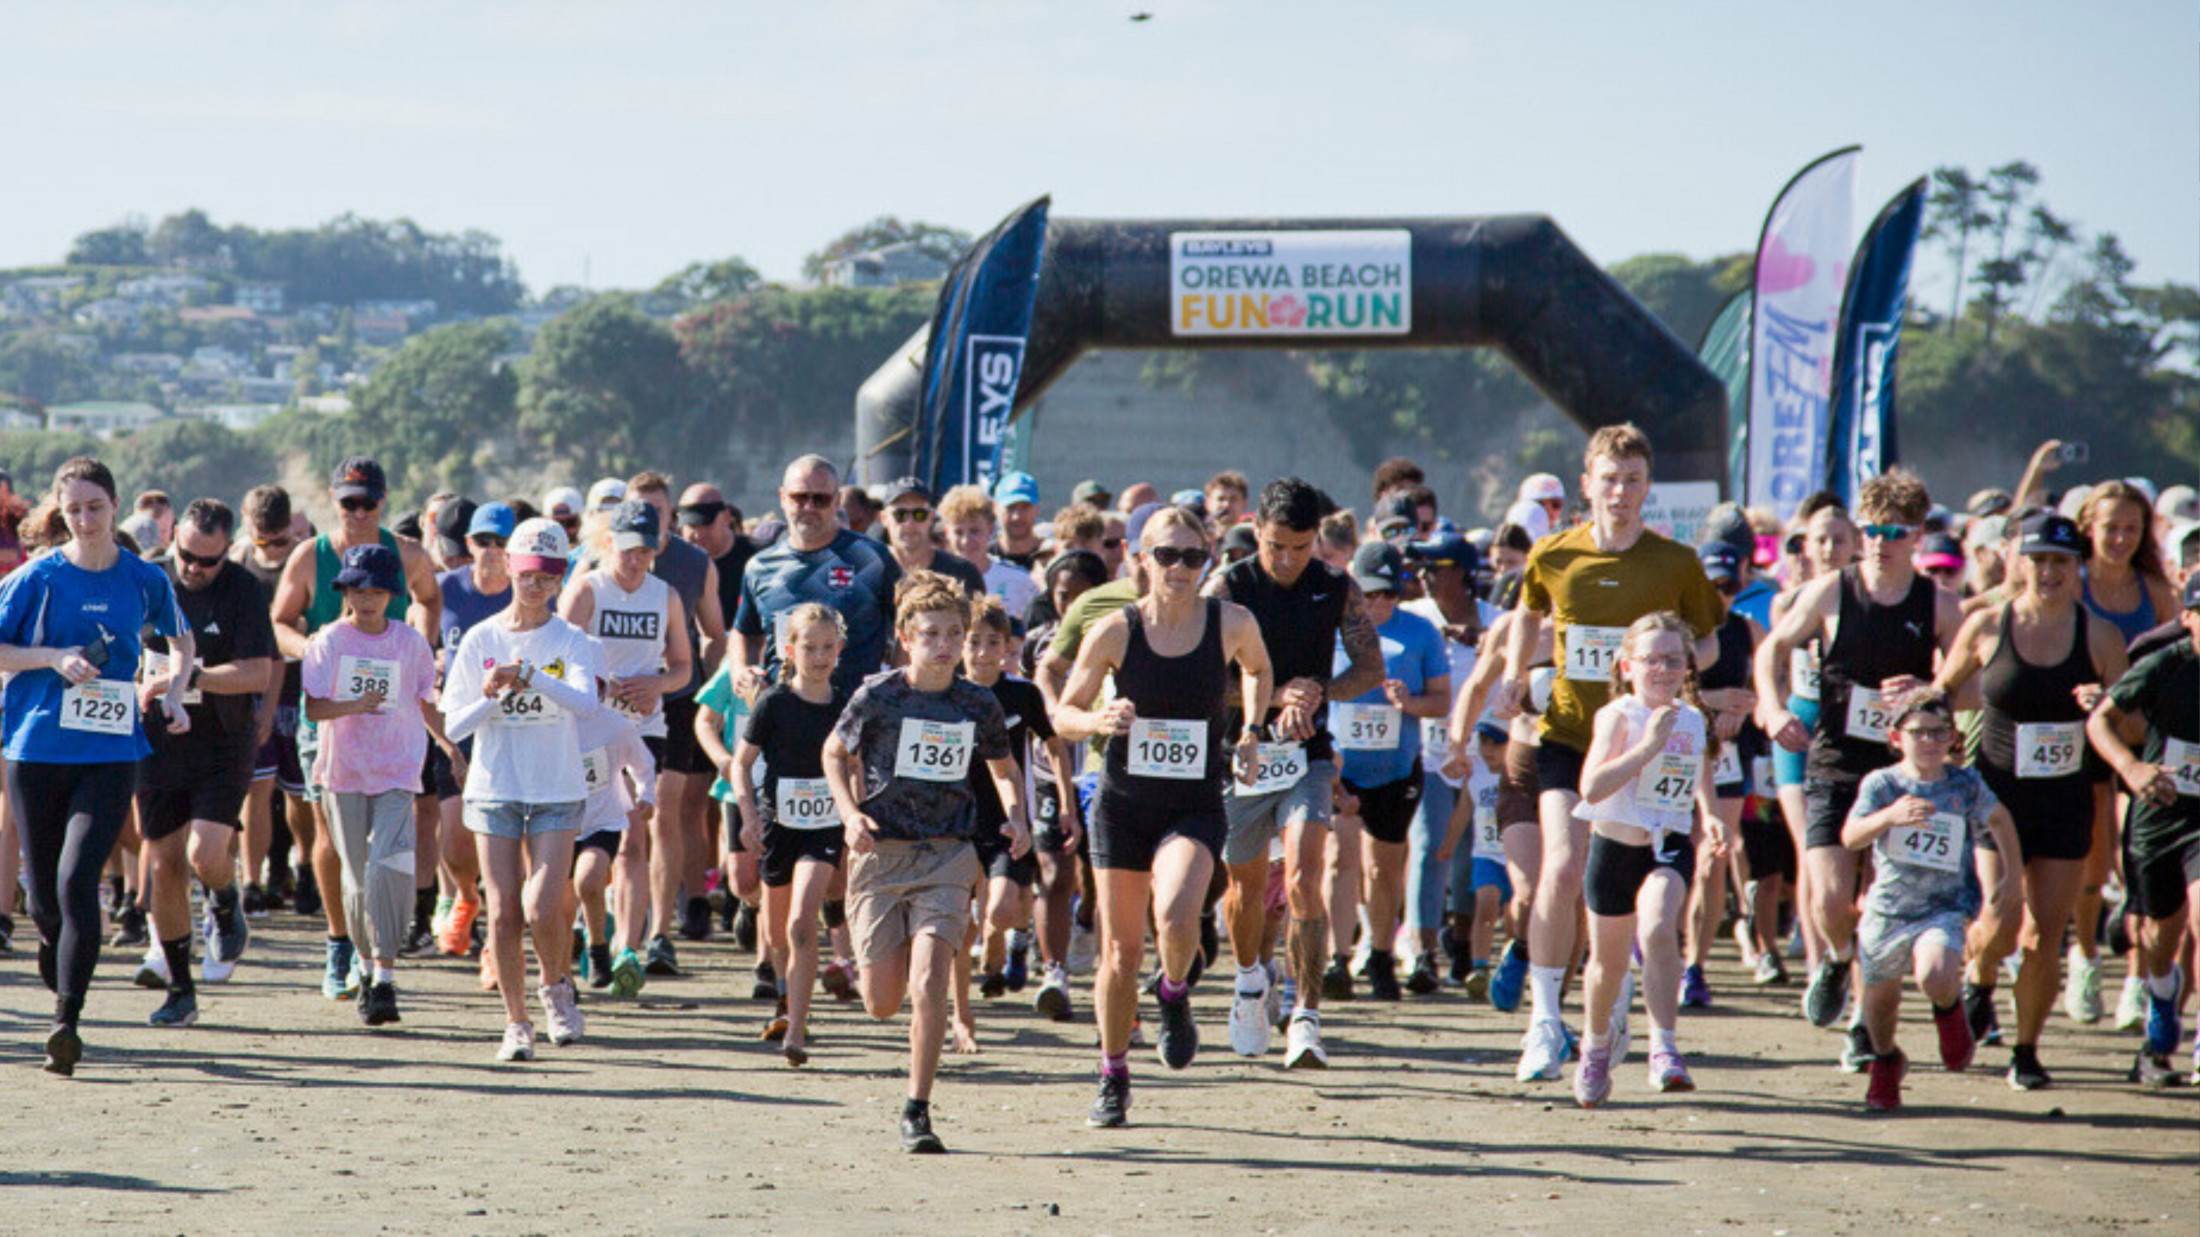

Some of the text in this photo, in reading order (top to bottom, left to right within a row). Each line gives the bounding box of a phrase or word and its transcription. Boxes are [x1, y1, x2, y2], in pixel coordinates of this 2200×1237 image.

[1181, 264, 1402, 288] OREWA BEACH
[1181, 294, 1402, 329] FUN RUN
[1770, 402, 1808, 504] ORE
[603, 613, 658, 639] NIKE
[1575, 647, 1614, 667] 111
[350, 676, 389, 696] 388
[72, 697, 127, 721] 1229
[1350, 721, 1389, 739] 319
[1428, 726, 1446, 744] 11
[908, 742, 965, 767] 1361
[1138, 740, 1198, 764] 1089
[2033, 744, 2074, 764] 459
[1256, 759, 1298, 780] 206
[785, 797, 836, 817] 1007
[1904, 831, 1950, 856] 475
